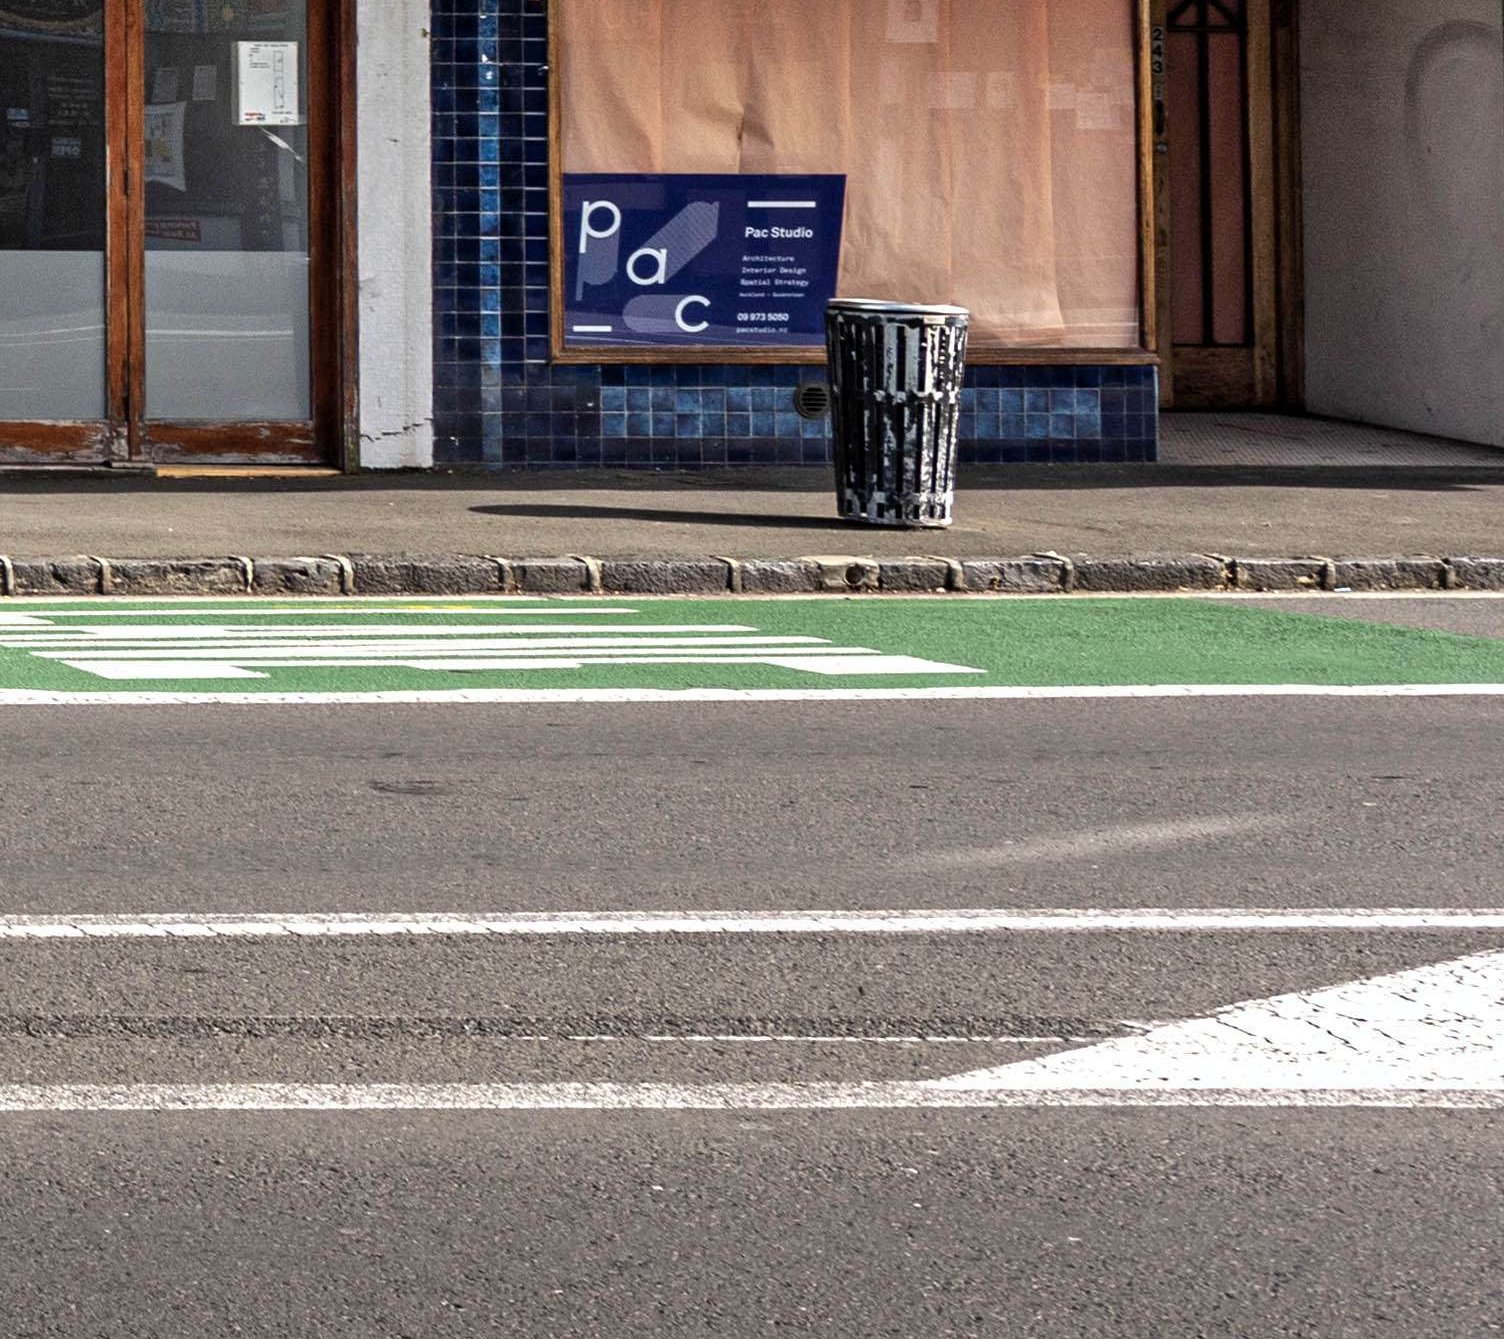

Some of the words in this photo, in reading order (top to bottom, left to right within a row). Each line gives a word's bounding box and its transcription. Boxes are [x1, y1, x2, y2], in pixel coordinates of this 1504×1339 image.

[1152, 28, 1163, 73] 243
[744, 227, 770, 239] Pac
[771, 226, 814, 239] Studio
[742, 254, 795, 262] Architecture
[737, 313, 751, 321] 09
